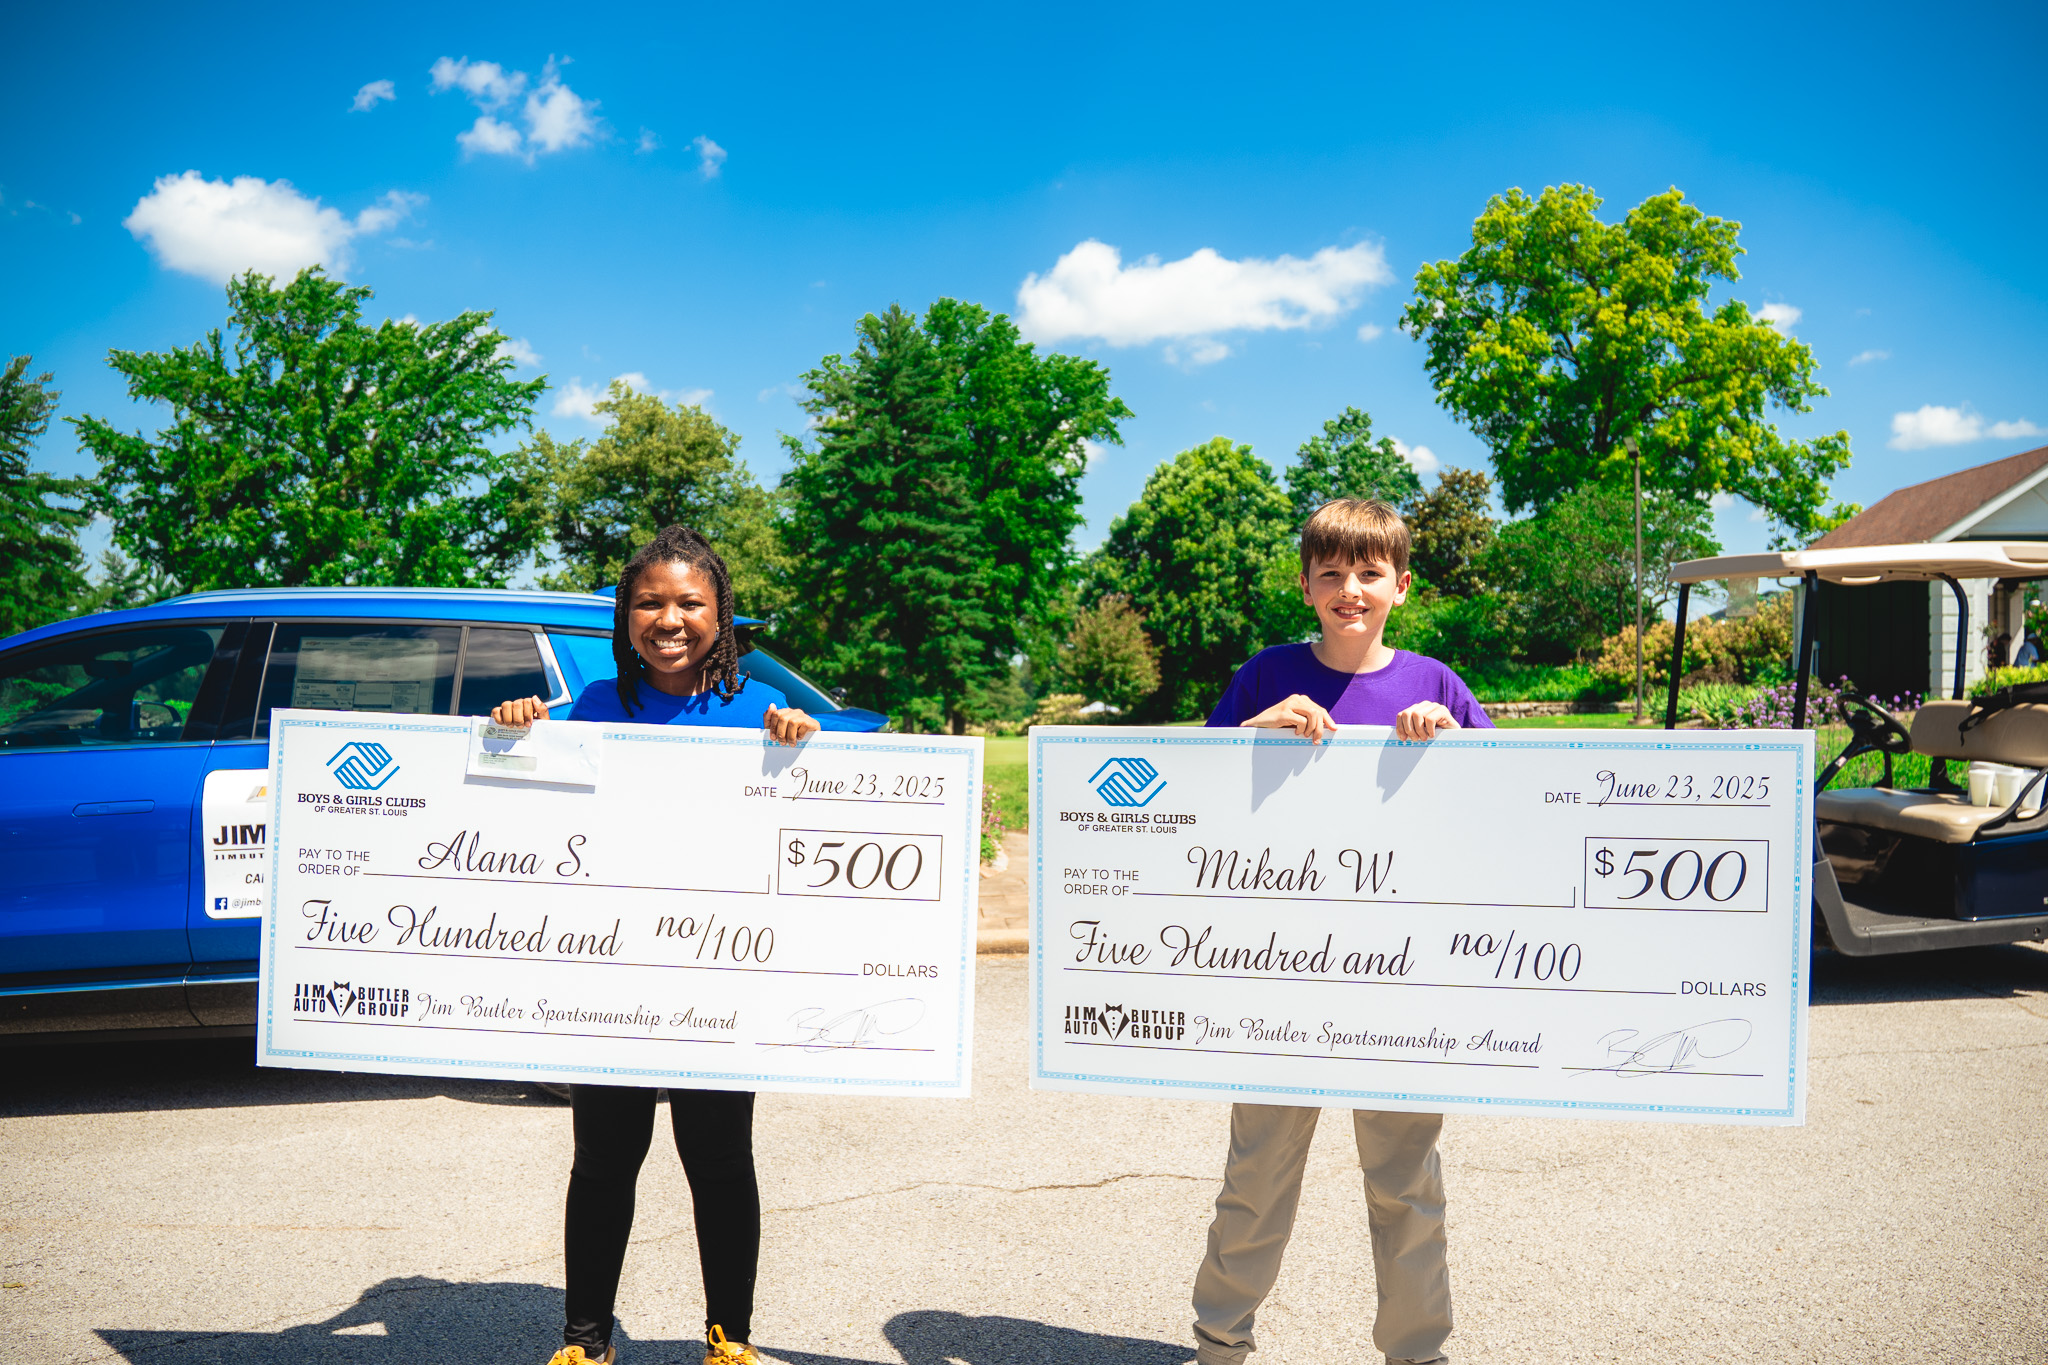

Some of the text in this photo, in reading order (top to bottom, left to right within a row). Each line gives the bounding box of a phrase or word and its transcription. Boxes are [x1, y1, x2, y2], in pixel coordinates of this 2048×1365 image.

[744, 766, 945, 801] DATE June 23, 2025
[1544, 770, 1770, 808] DATE June 23, 2025
[297, 793, 426, 808] BOYS & GIRLS CLUBS
[314, 805, 409, 817] OF GREATER ST. LOUIS
[1059, 811, 1197, 825] BOYS & GIRLS CLUBS
[213, 824, 266, 846] JIM
[1077, 823, 1178, 834] OF GREATER ST. LOUIS
[298, 847, 371, 862] PAY TO THE
[418, 830, 590, 878] Alana S.
[787, 837, 923, 891] $500
[298, 863, 361, 876] ORDER OF
[1064, 867, 1139, 881] PAY TO THE
[1187, 845, 1397, 895] Mikah W.
[1594, 846, 1747, 902] $500
[1064, 883, 1130, 896] ORDER OF
[232, 898, 262, 909] @jimb
[301, 899, 380, 944] Five
[387, 904, 552, 953] Hundred
[557, 918, 624, 957] and
[863, 963, 938, 979] DOLLARS
[1069, 920, 1152, 965] Five
[1160, 925, 1337, 974] Hundred
[1342, 936, 1415, 977] and
[1681, 980, 1767, 997] DOLLARS
[294, 983, 410, 1002] JIM BUTLER
[294, 998, 409, 1018] AUTO GROUP
[417, 993, 455, 1022] Jim
[460, 995, 526, 1020] Butler
[531, 998, 663, 1034] Sportsmanship
[669, 1007, 739, 1030] Award
[1064, 1005, 1185, 1025] JIM BUTLER
[1064, 1020, 1185, 1041] AUTO GROUP
[1193, 1015, 1235, 1045] Jim
[1239, 1017, 1310, 1043] Butler
[1316, 1021, 1460, 1057] Sportsmanship
[1466, 1029, 1543, 1054] Award
